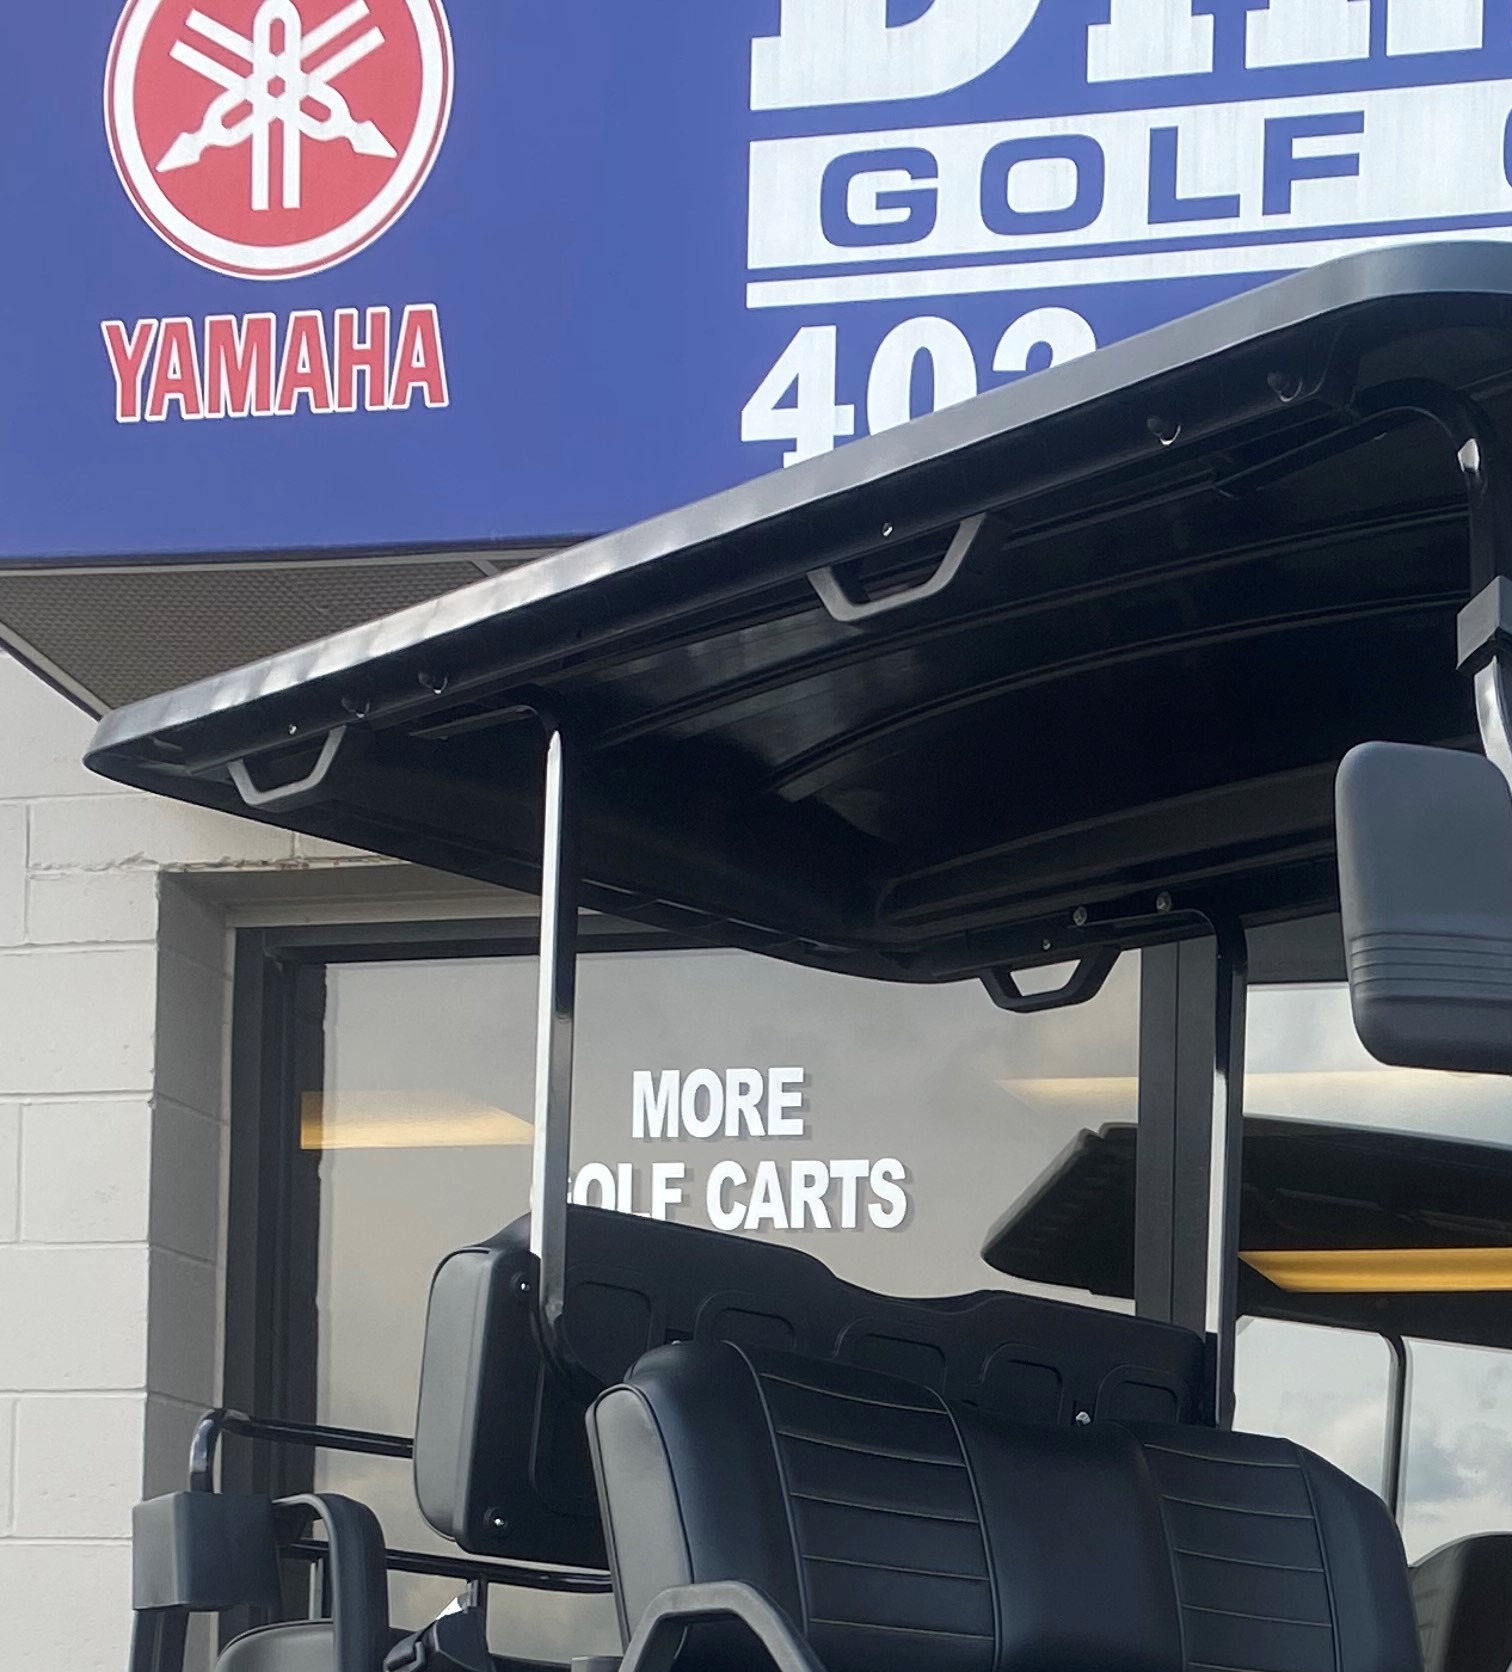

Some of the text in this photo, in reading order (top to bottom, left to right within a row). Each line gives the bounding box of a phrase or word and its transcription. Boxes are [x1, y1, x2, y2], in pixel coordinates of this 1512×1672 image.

[820, 110, 1365, 248] GOLF
[101, 303, 449, 423] YAMAHA
[632, 1067, 805, 1138] MORE
[567, 1157, 907, 1231] OLF CARTS
